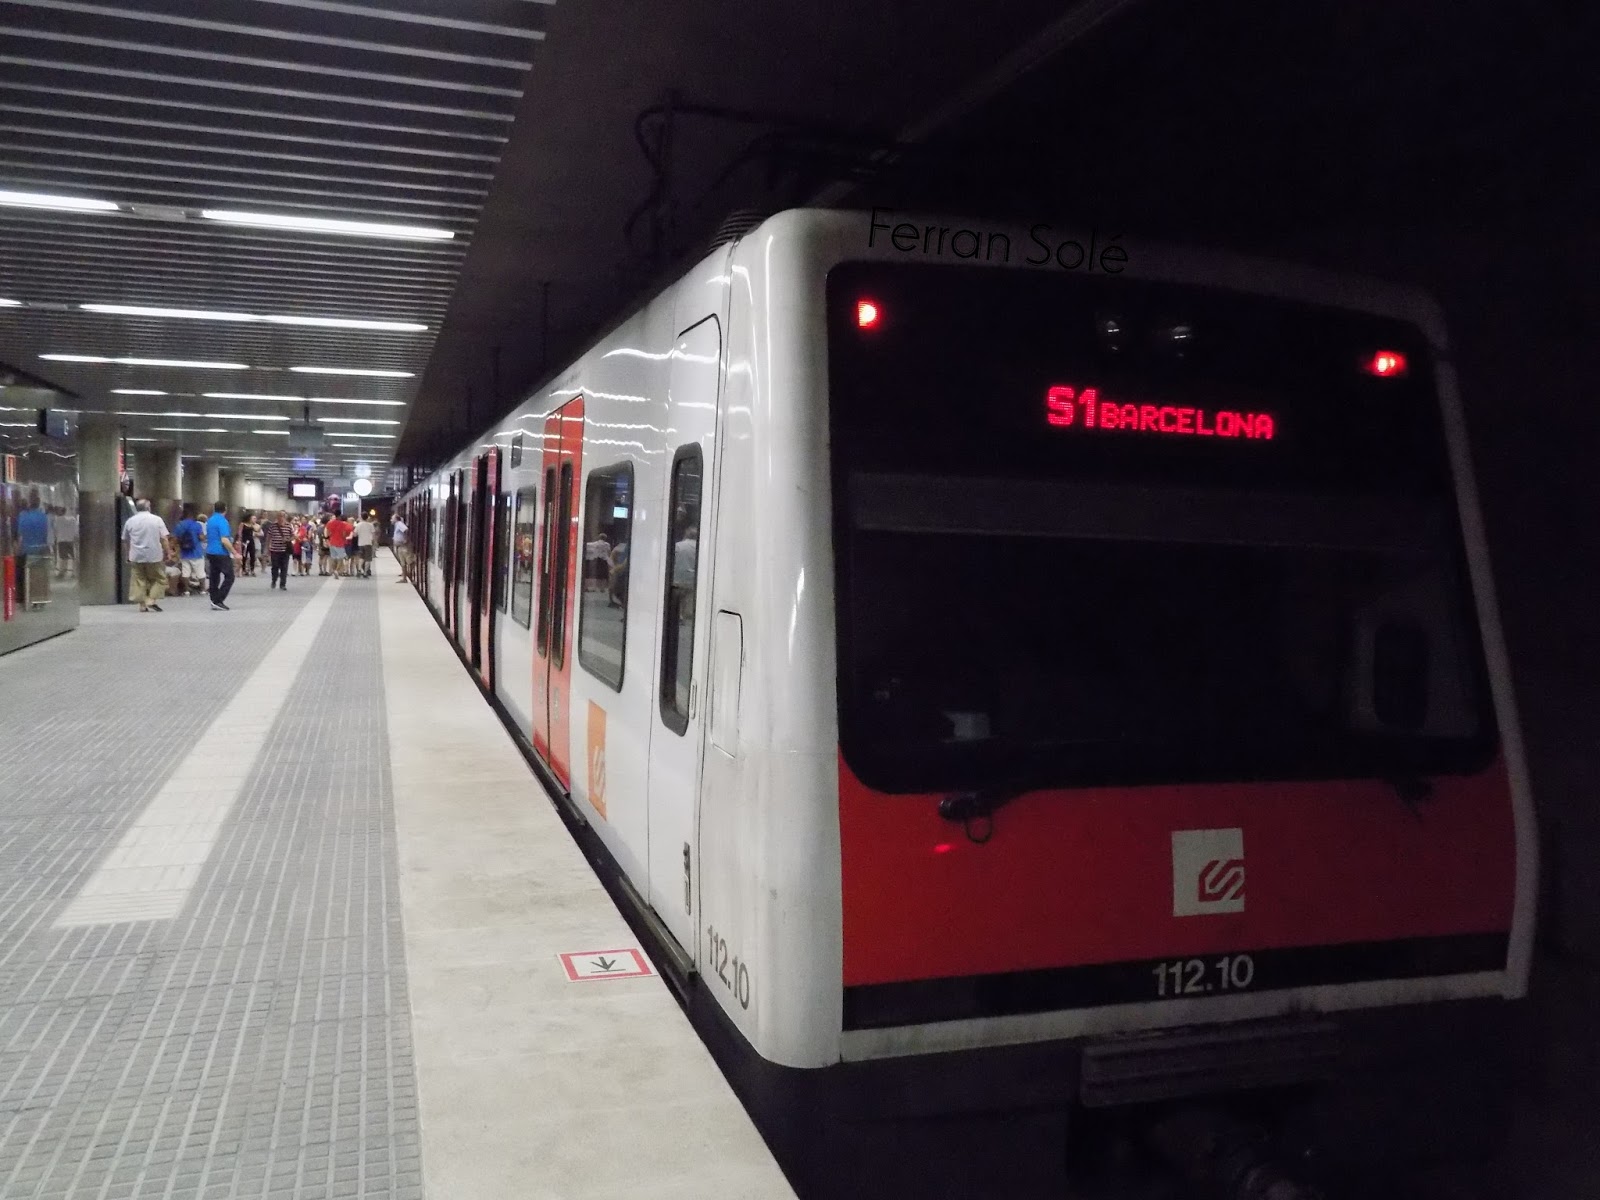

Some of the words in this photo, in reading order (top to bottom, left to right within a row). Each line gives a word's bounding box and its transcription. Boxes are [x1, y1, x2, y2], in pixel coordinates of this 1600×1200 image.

[1047, 386, 1096, 428] S1
[1100, 402, 1274, 440] BARCELONA
[707, 924, 750, 1010] 112.10
[1152, 954, 1254, 996] 112.10
